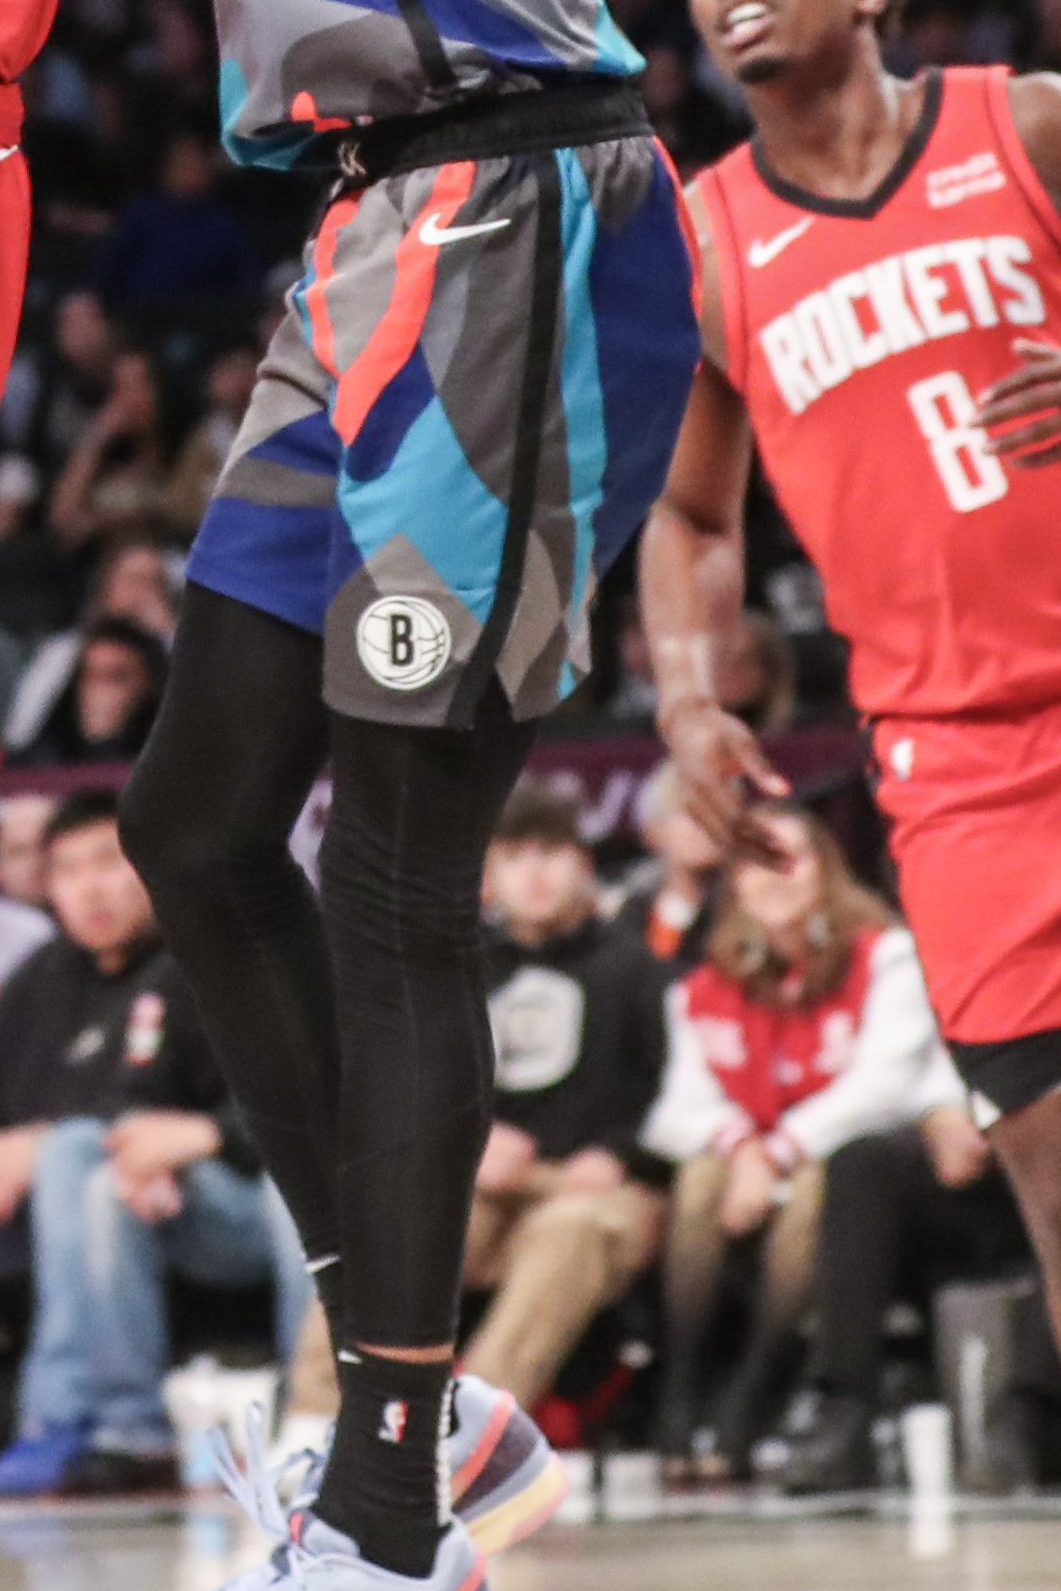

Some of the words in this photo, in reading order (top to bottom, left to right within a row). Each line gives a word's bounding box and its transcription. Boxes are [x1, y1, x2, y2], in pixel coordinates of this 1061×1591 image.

[759, 235, 1045, 415] ROCKETS
[907, 370, 1008, 513] 8
[390, 613, 415, 666] B
